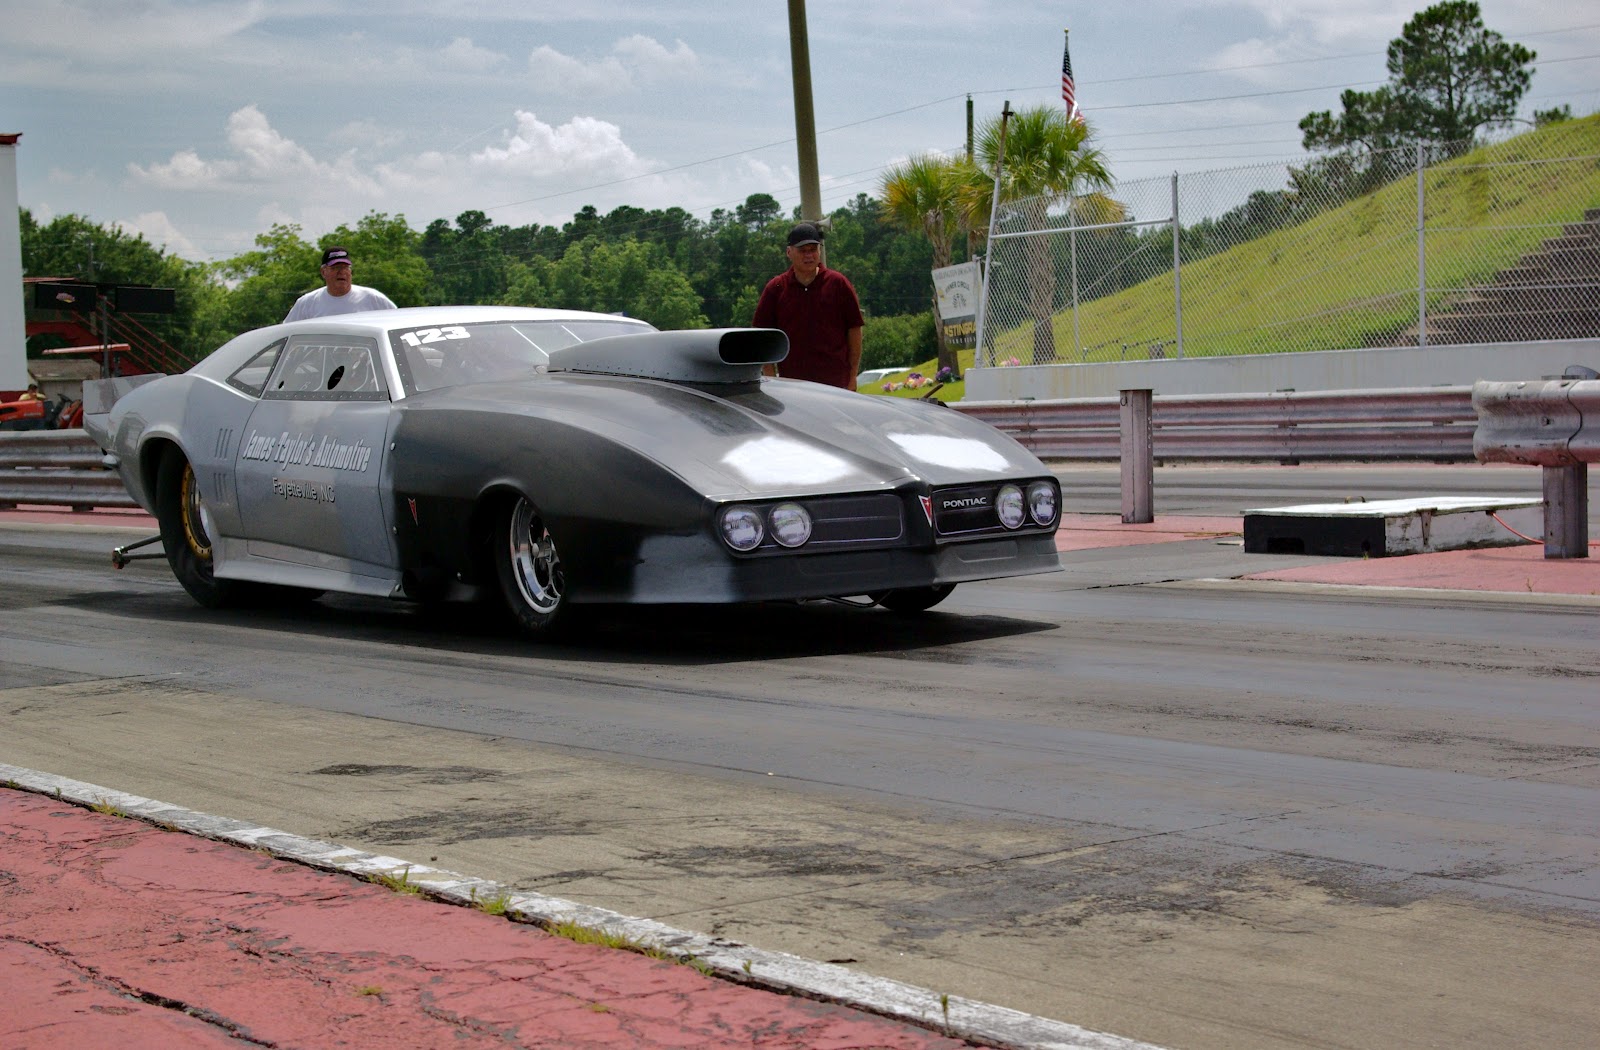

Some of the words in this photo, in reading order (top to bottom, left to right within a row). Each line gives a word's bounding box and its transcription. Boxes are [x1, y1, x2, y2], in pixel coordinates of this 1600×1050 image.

[400, 326, 471, 347] 123
[242, 429, 277, 461] James
[273, 431, 316, 471] Taylor's
[313, 434, 371, 472] Automotive
[272, 477, 321, 504] Fayetteville,
[320, 484, 335, 503] NC
[943, 496, 987, 508] PONTIAC
